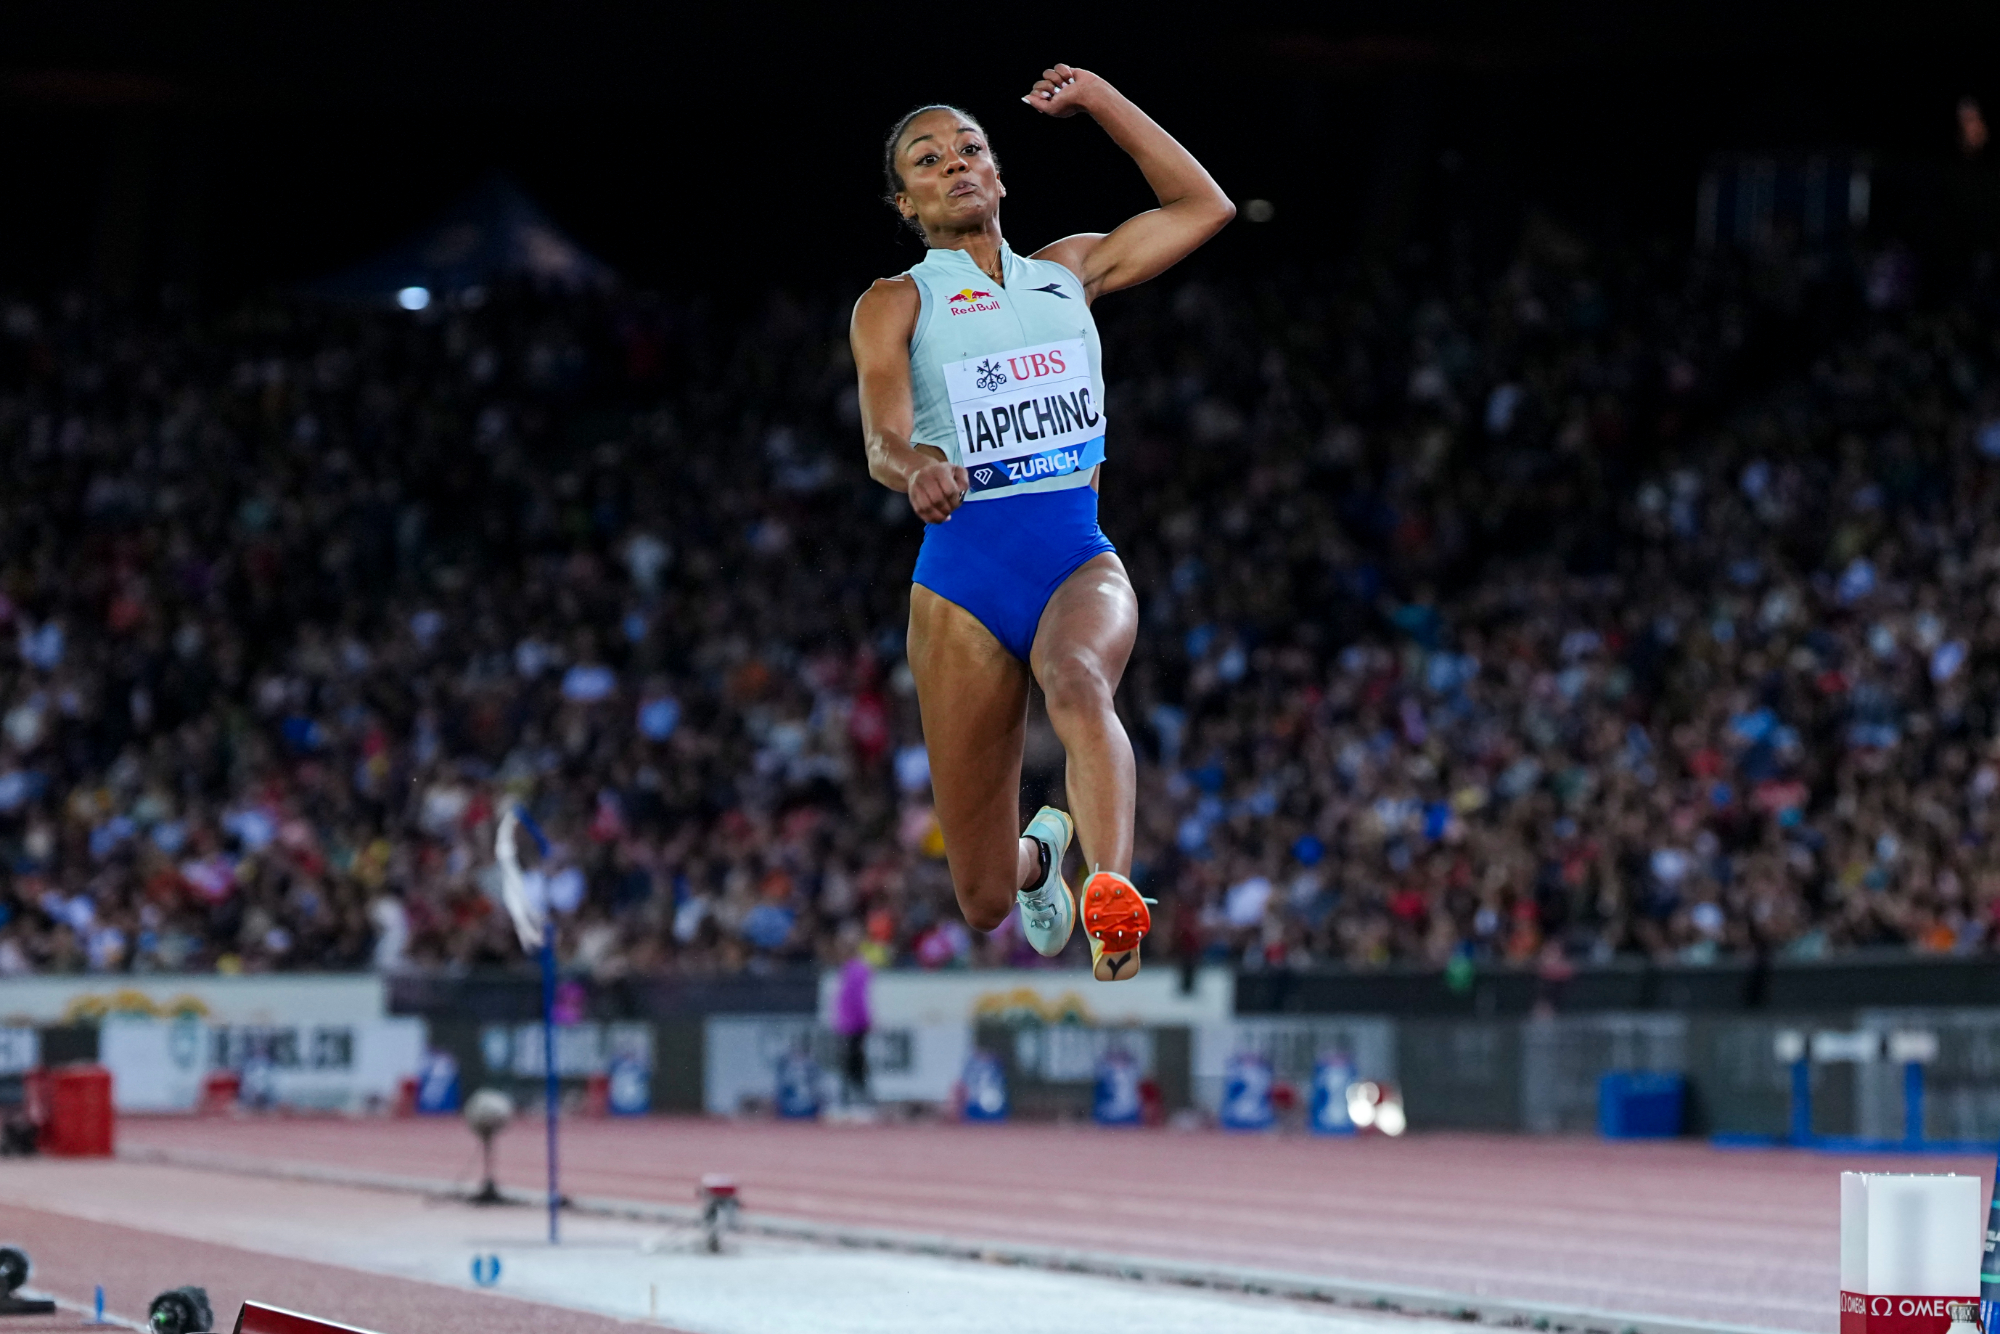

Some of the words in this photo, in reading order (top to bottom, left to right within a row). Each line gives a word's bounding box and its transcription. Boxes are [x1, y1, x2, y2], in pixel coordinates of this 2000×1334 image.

[951, 304, 976, 316] Red
[976, 301, 1001, 312] Bull
[1007, 350, 1066, 381] UBS
[1007, 450, 1079, 480] ZURICH
[1848, 1296, 1866, 1315] OMEGA
[1899, 1299, 1972, 1317] OME
